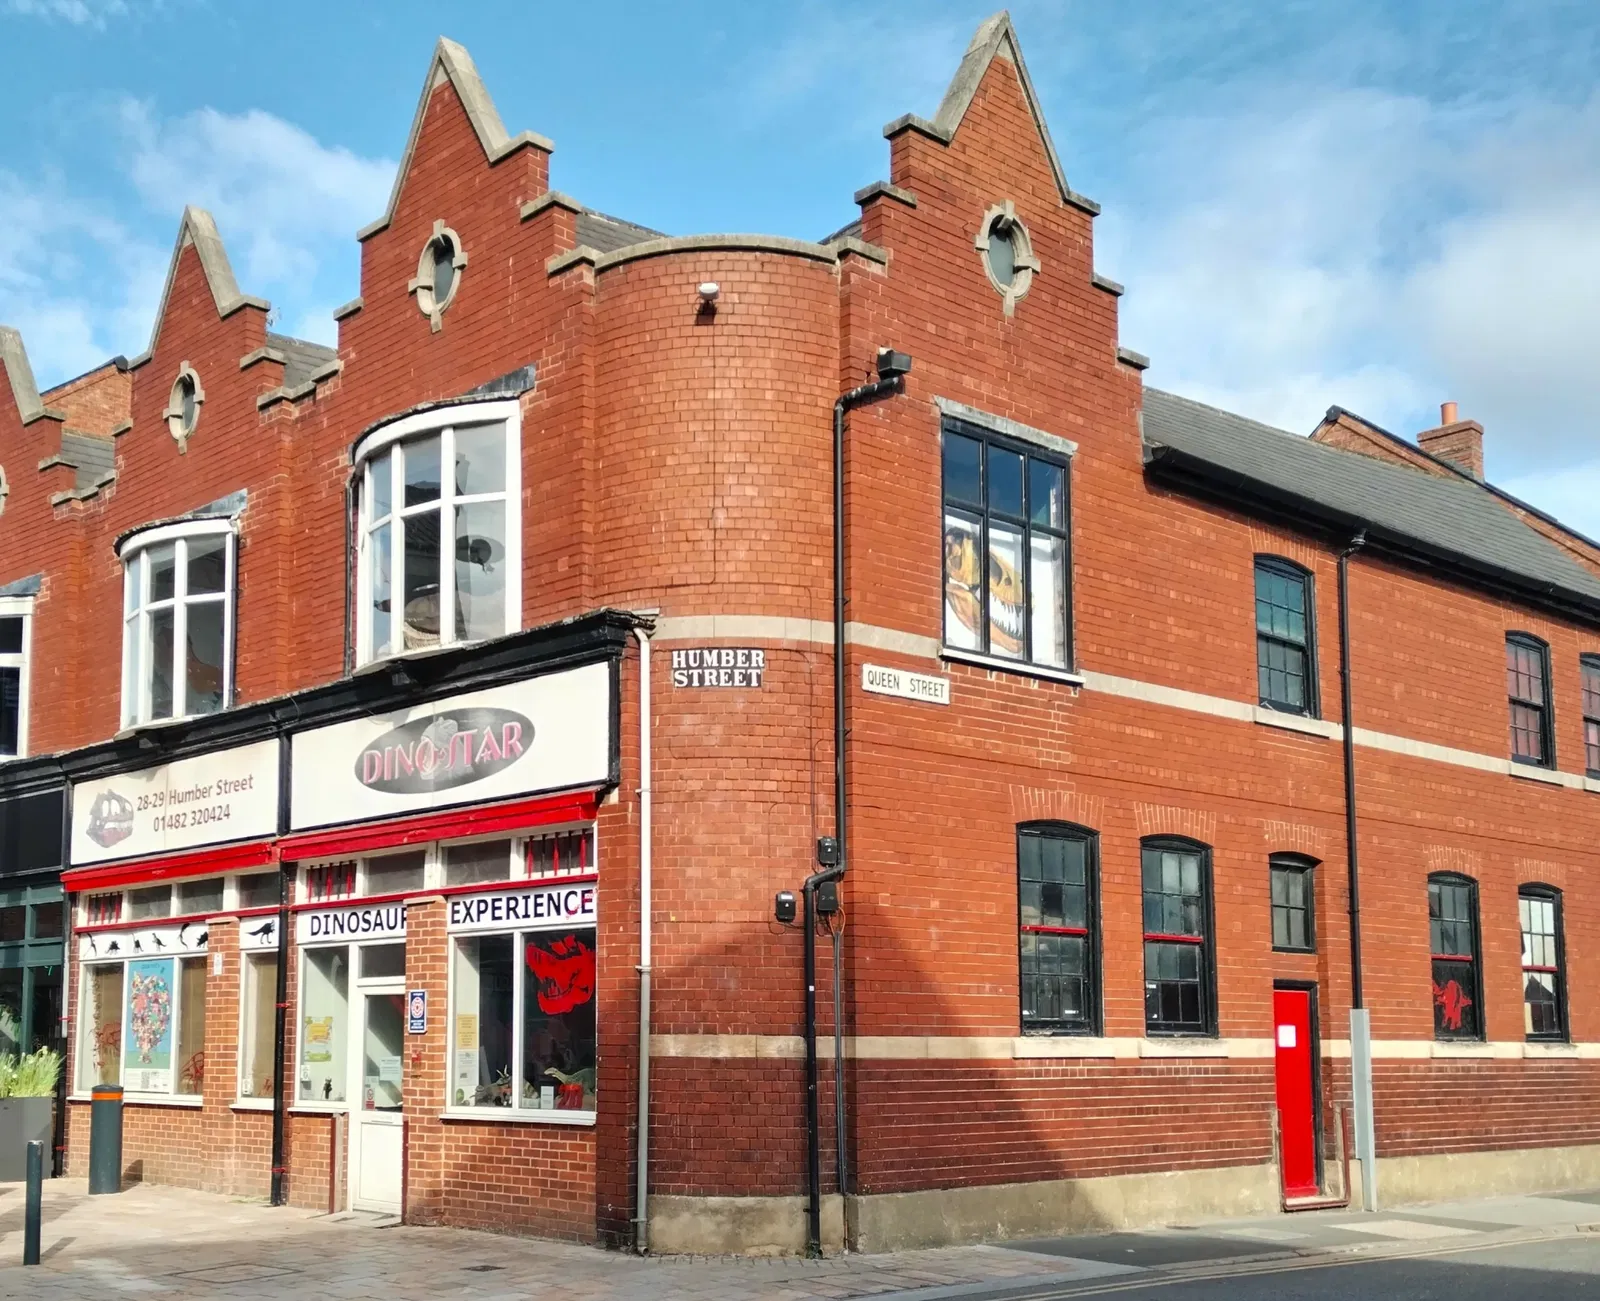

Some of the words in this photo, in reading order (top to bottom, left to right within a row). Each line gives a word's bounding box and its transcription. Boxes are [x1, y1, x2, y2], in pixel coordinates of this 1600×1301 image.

[672, 649, 764, 668] HUMBER
[674, 669, 760, 687] STREET
[867, 670, 900, 690] QUEEN
[909, 678, 945, 698] STREET
[137, 791, 165, 811] 28-29
[168, 783, 213, 805] Humber
[216, 774, 254, 796] Street
[153, 812, 187, 832] 01482
[190, 804, 230, 826] 320424
[451, 889, 594, 924] EXPERIENCE
